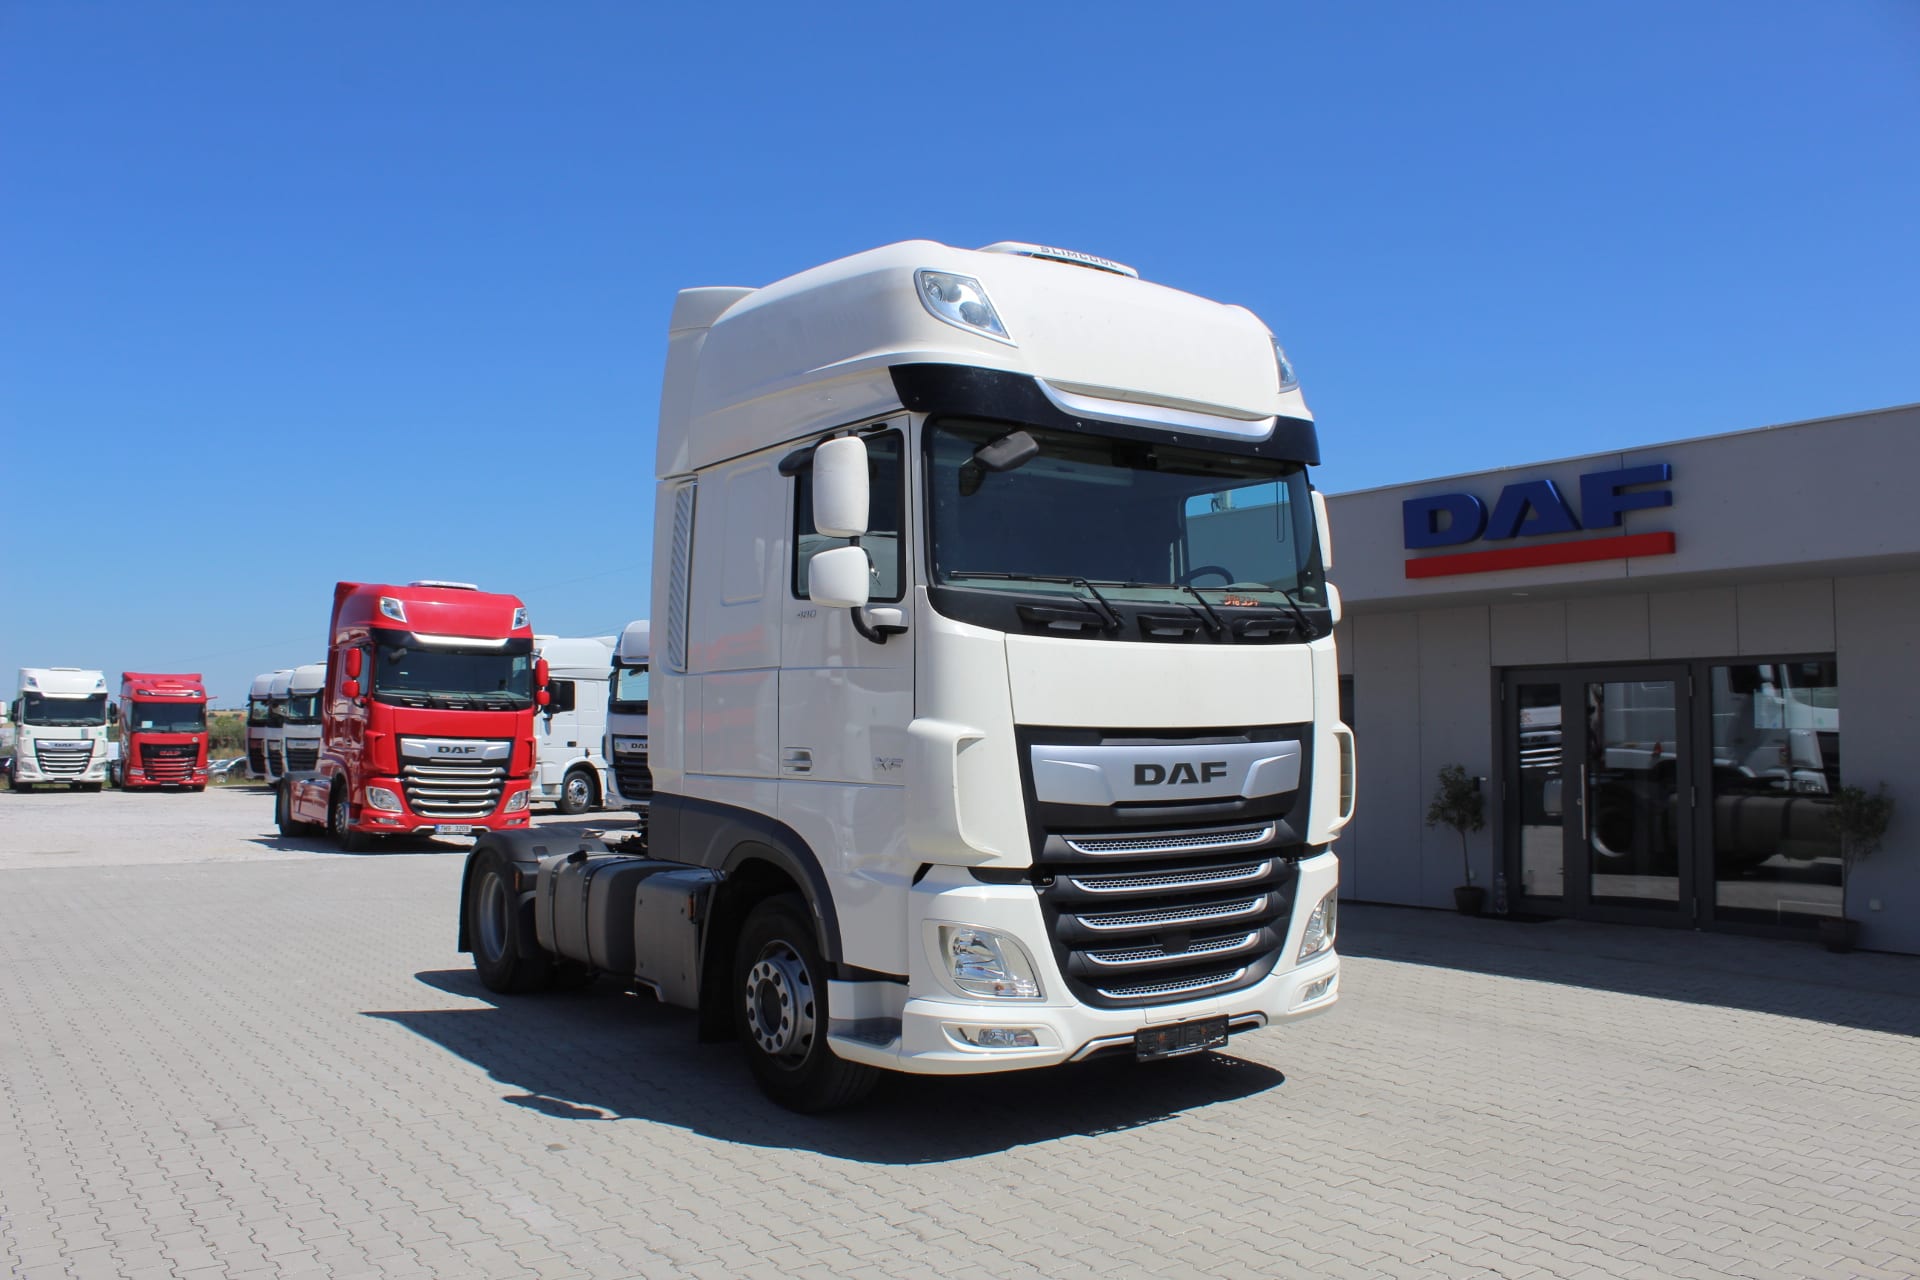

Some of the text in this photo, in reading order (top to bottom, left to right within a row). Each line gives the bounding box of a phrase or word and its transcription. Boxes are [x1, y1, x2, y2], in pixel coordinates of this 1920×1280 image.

[1402, 463, 1672, 549] DAF
[438, 746, 476, 754] DAF
[1134, 761, 1227, 786] DAF
